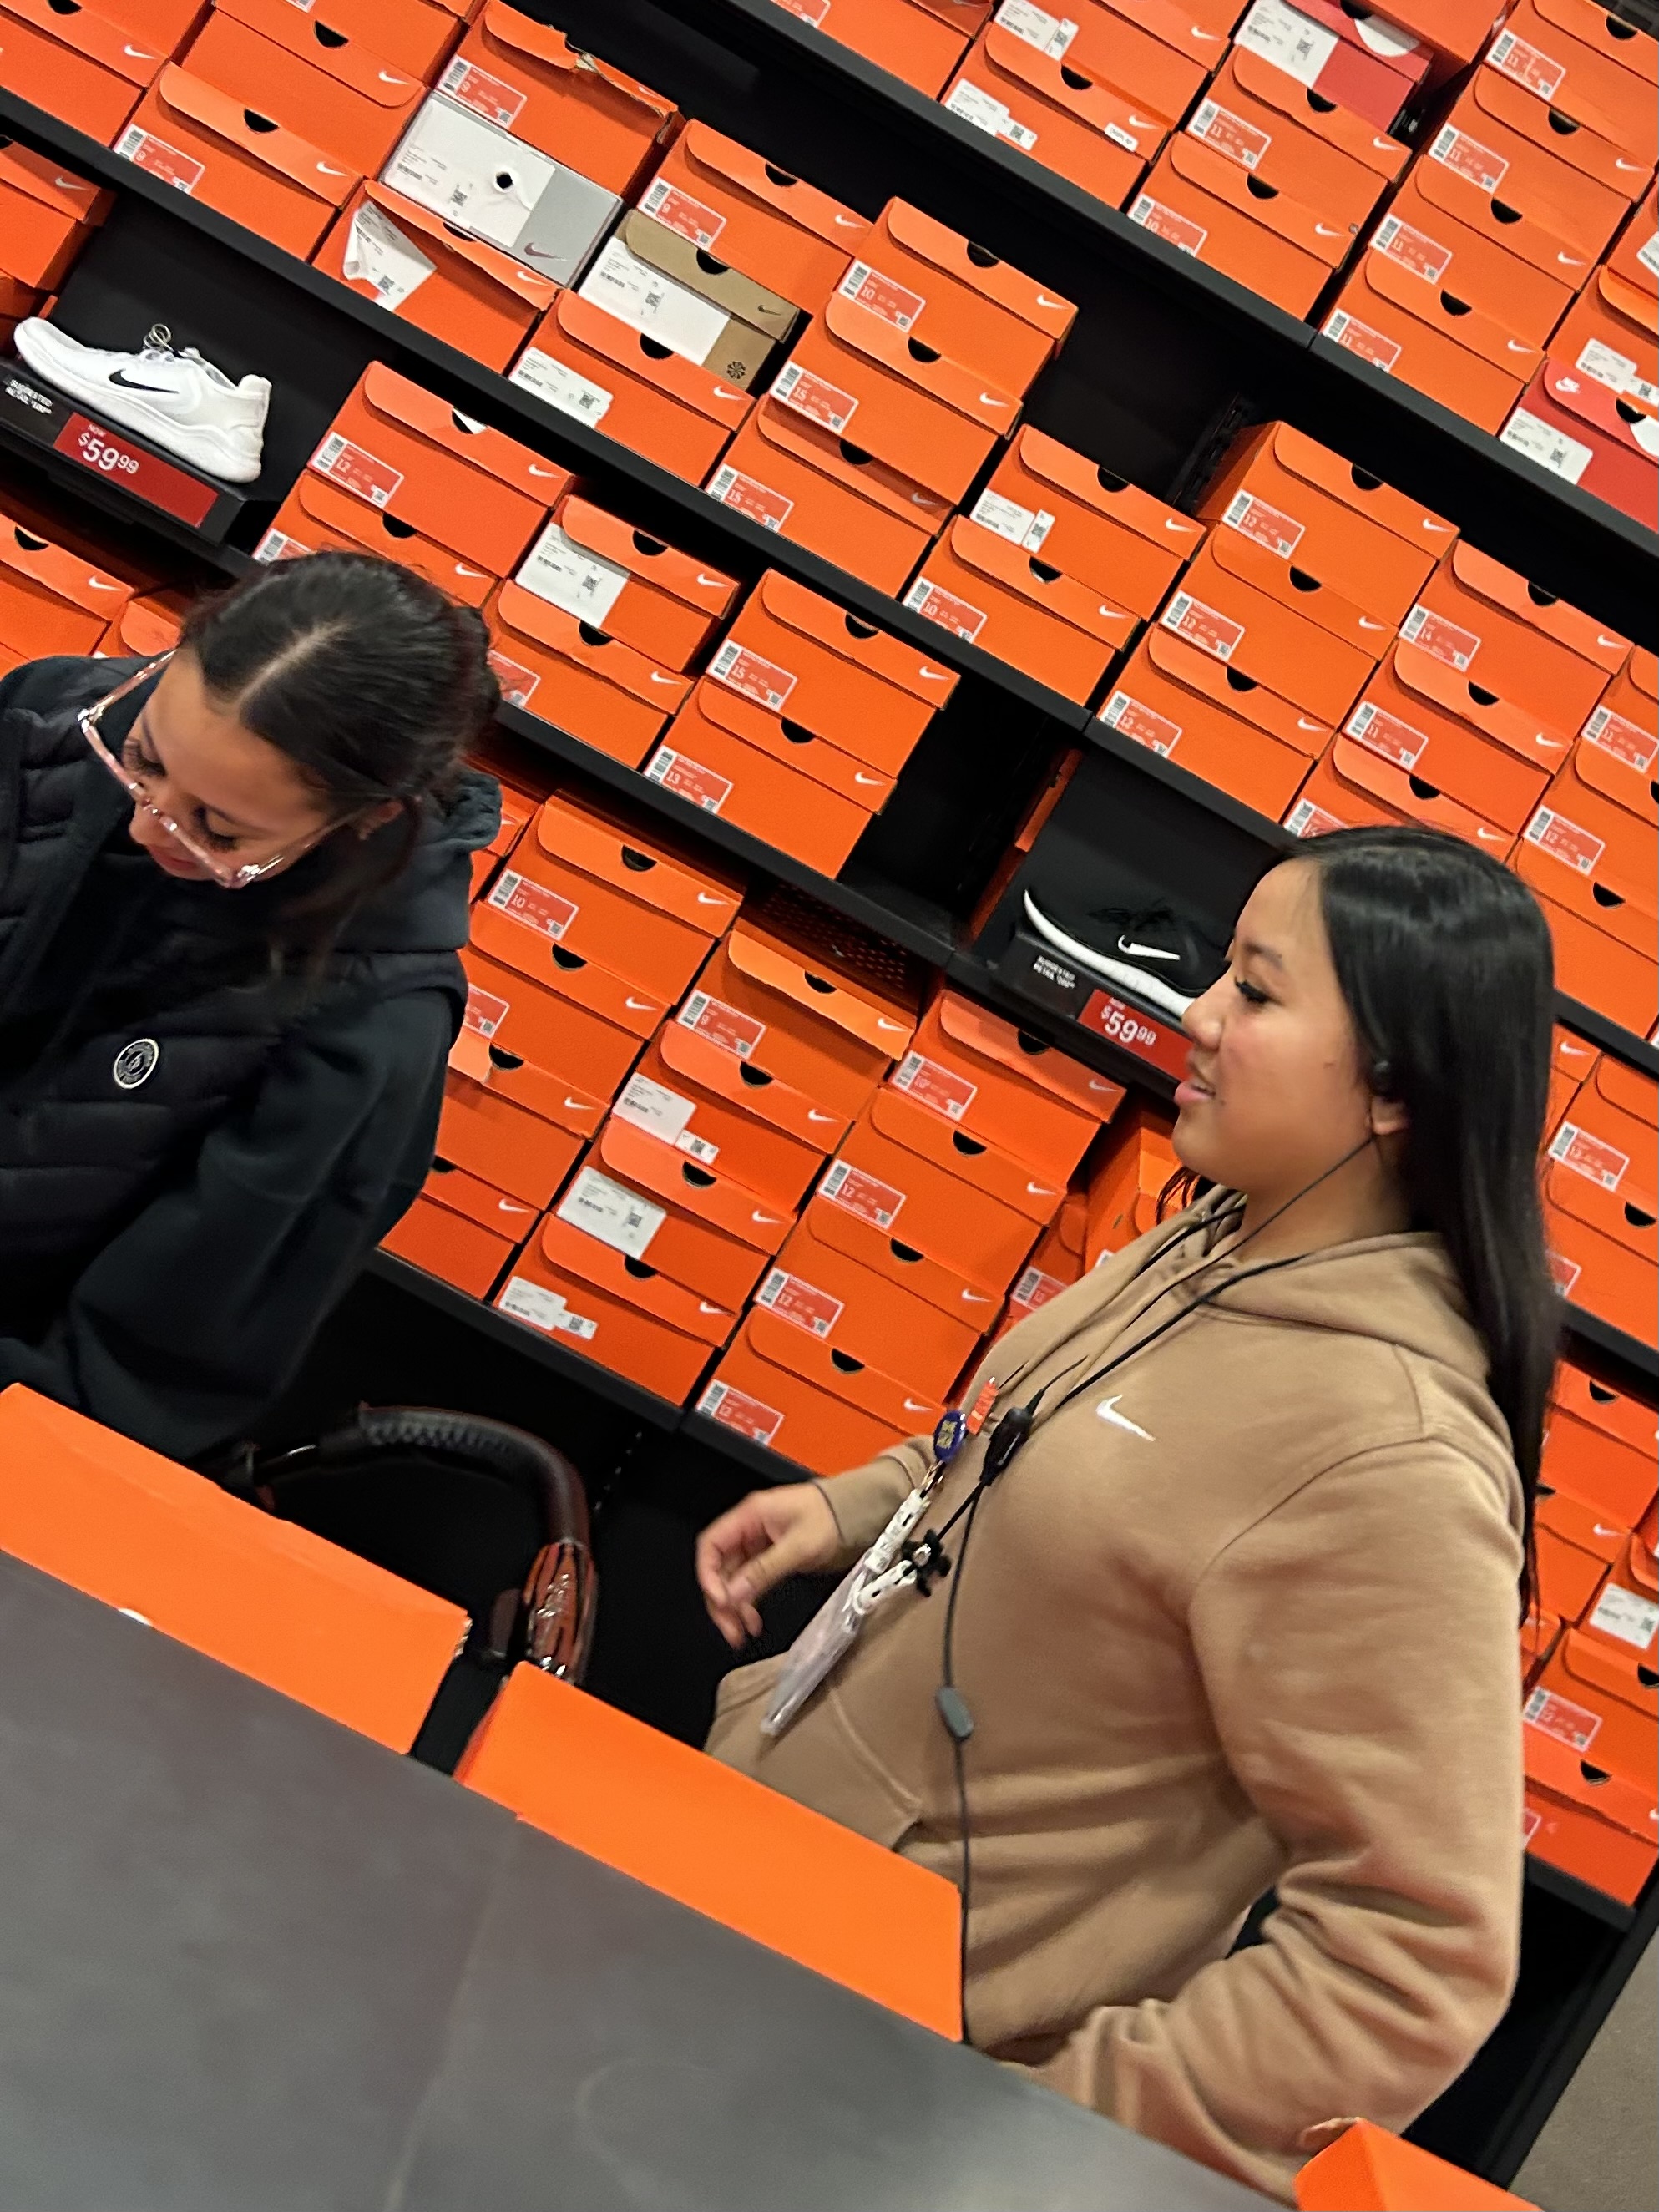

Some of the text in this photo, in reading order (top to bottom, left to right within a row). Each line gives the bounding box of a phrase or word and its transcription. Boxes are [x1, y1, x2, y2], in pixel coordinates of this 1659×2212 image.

[1211, 124, 1223, 137] 11
[1145, 218, 1160, 232] 10
[860, 286, 875, 300] 10
[793, 387, 807, 401] 15
[88, 424, 105, 438] NOW
[336, 458, 351, 473] 12
[728, 489, 742, 504] 15
[923, 602, 938, 616] 10
[731, 665, 746, 679] 15
[666, 771, 681, 785] 13
[511, 894, 526, 909] 10
